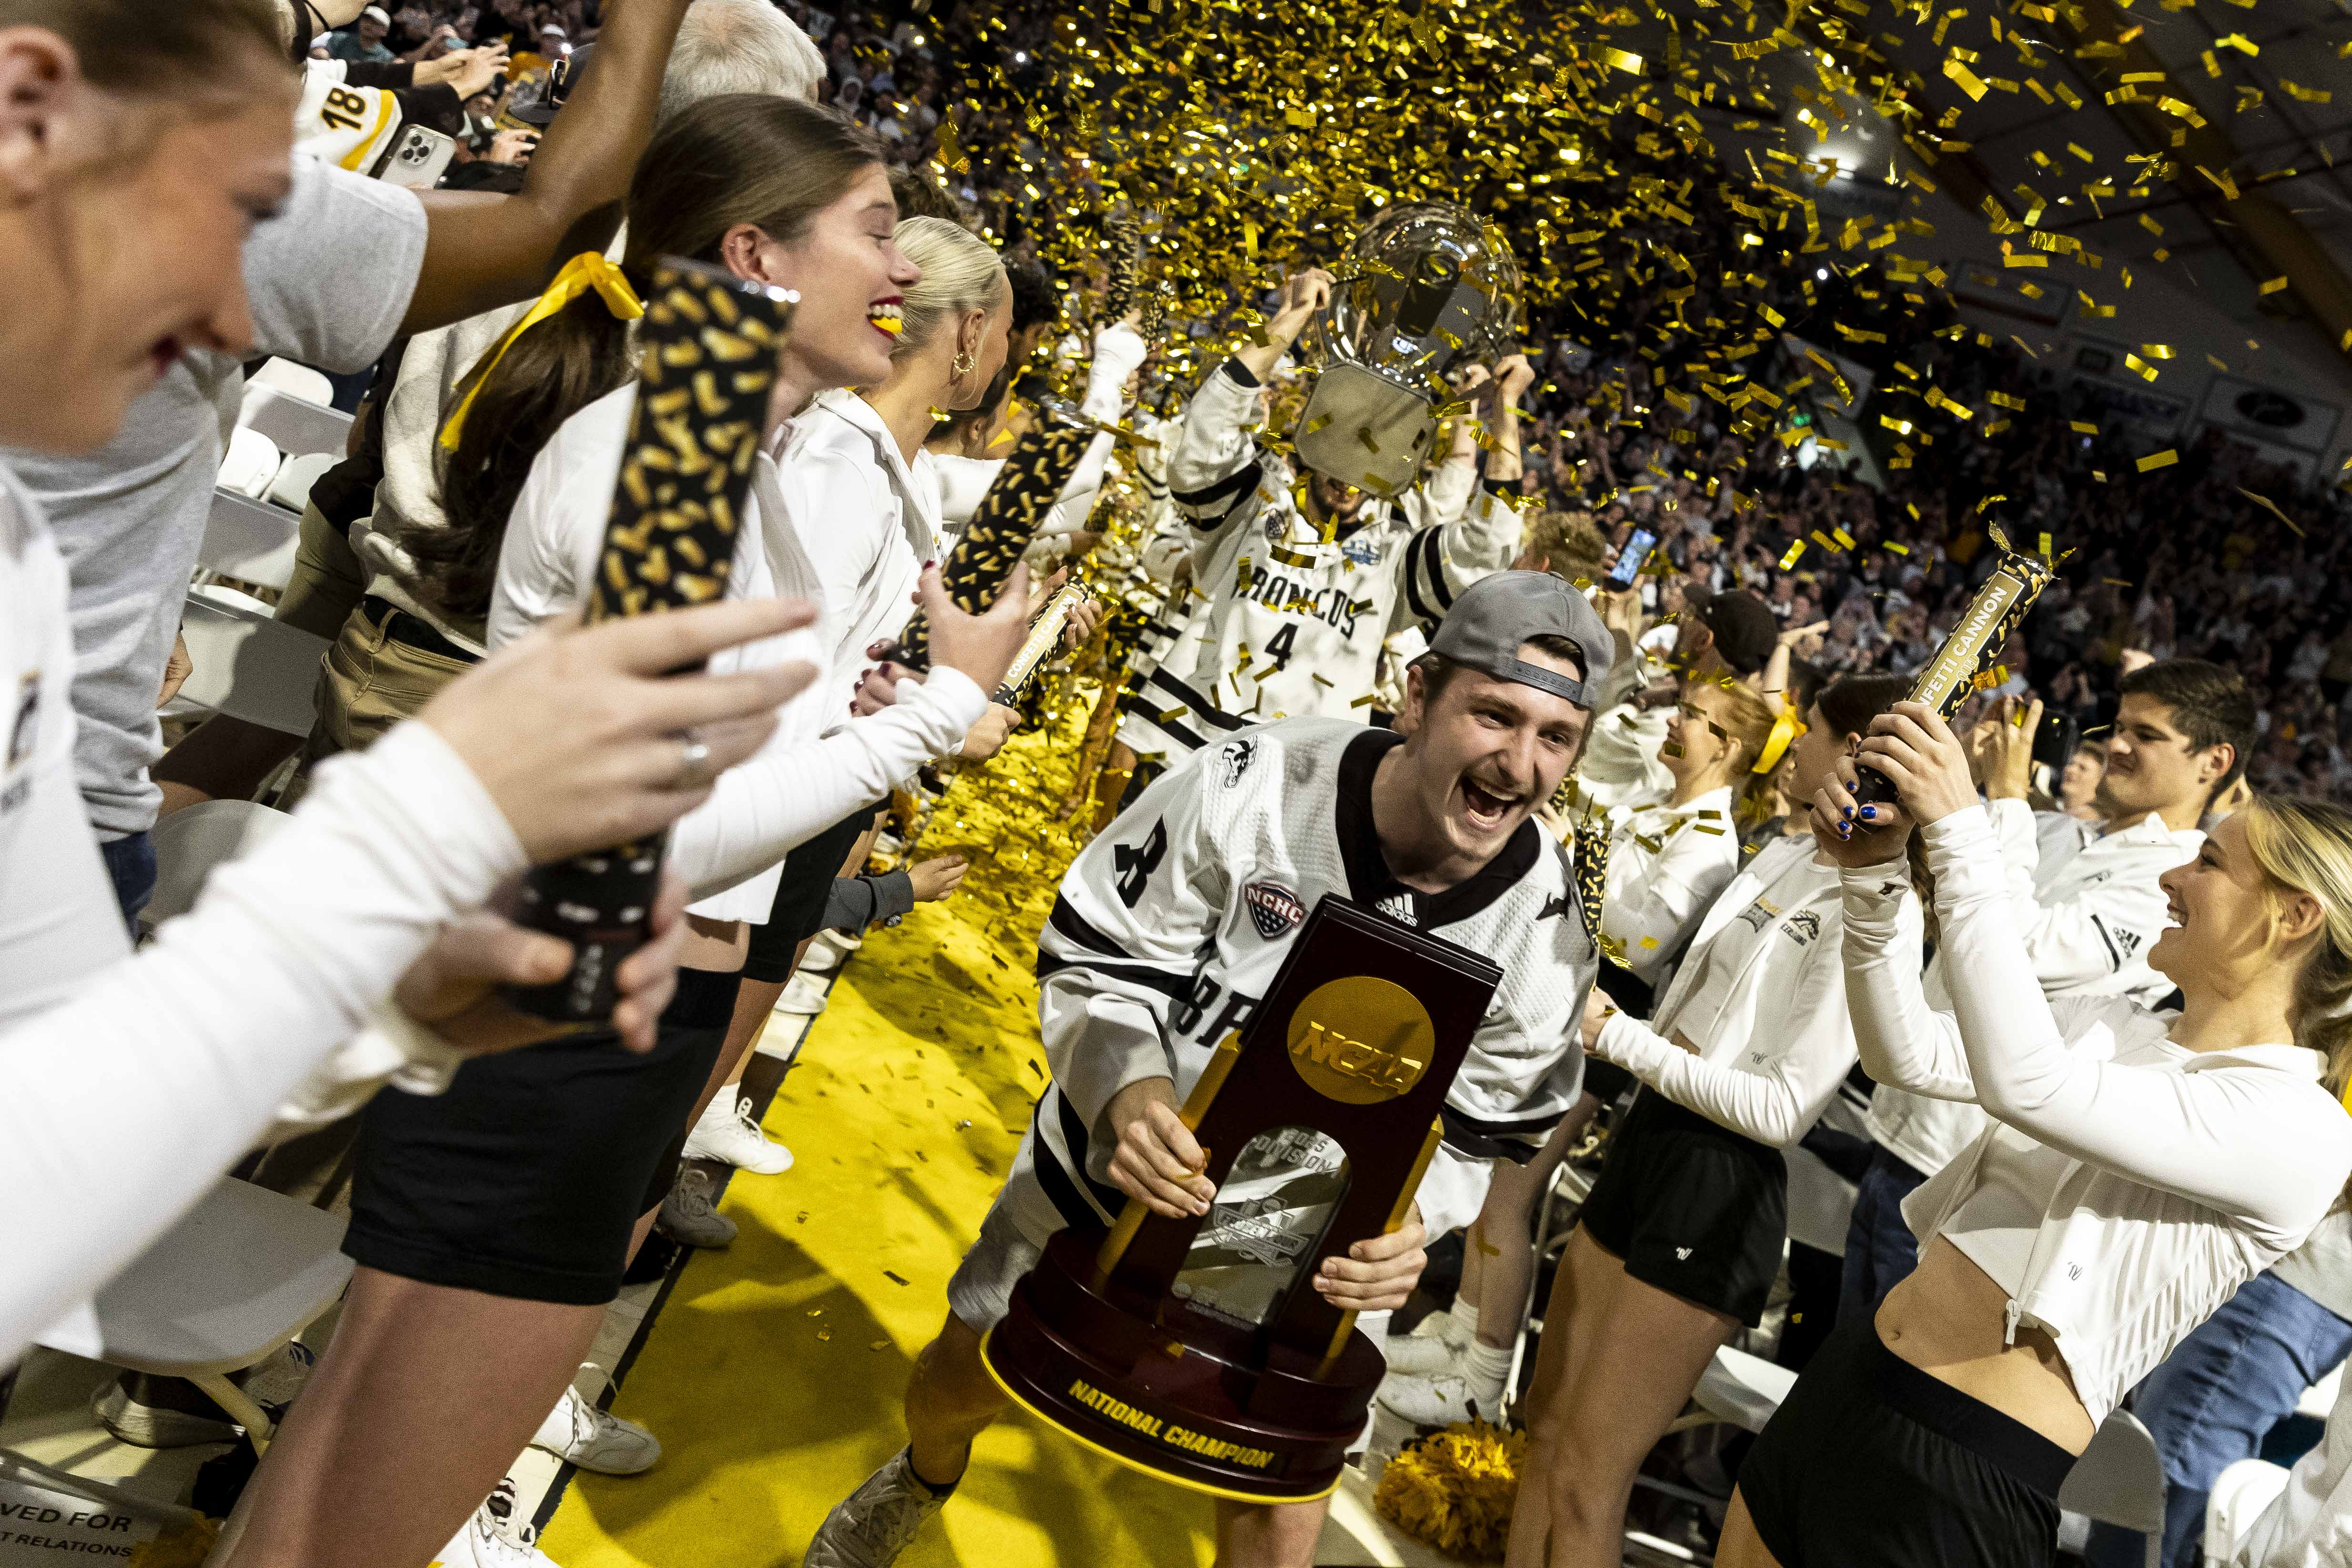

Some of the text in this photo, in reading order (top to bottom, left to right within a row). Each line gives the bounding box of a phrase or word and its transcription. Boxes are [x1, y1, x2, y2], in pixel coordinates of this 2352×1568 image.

[321, 87, 366, 130] 18
[1953, 585, 2008, 656] CANNON
[1007, 633, 1045, 678] CONFETTI
[1265, 622, 1299, 671] 4
[1246, 886, 1304, 924] NCHC
[1375, 901, 1418, 927] adidas
[1292, 1020, 1423, 1095] NCAA
[1252, 1134, 1333, 1175] DIVISION
[1068, 1379, 1275, 1468] NATIONAL CHAMPION
[68, 1512, 132, 1532] FOR
[15, 1534, 134, 1557] RELATIONS
